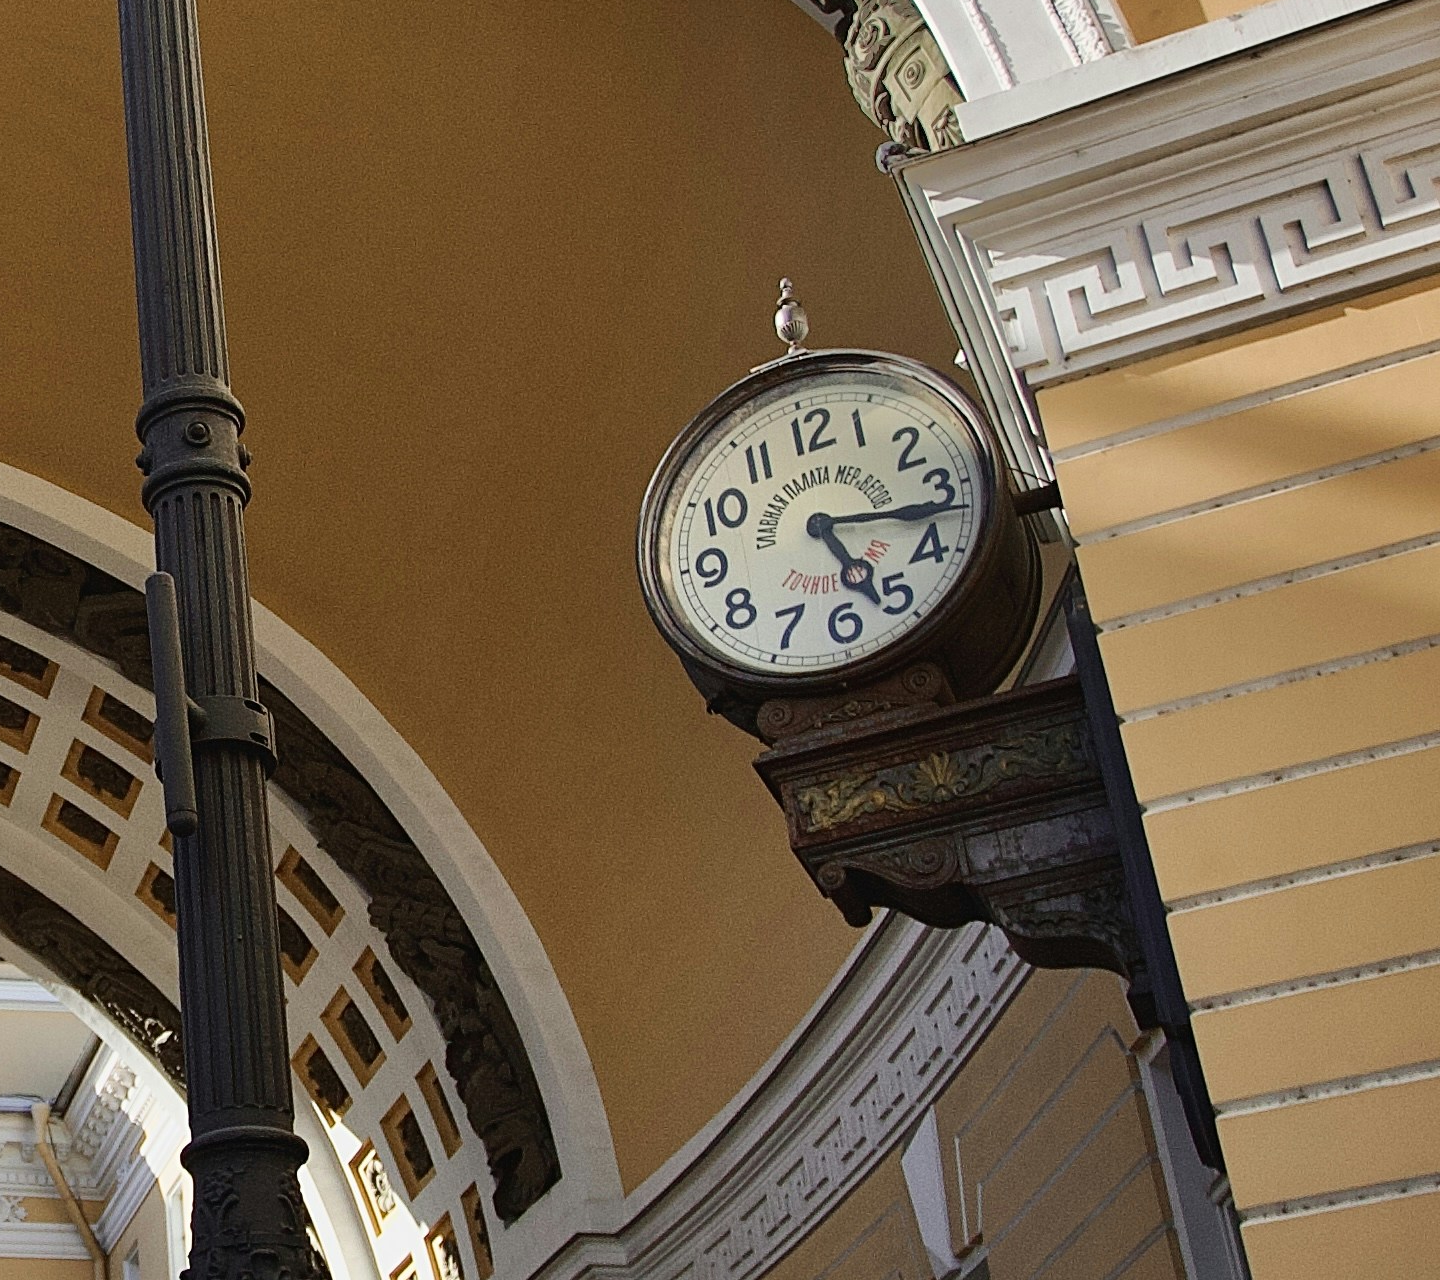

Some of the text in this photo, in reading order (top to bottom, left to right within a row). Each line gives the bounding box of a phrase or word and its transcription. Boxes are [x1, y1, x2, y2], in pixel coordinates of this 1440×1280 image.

[790, 407, 837, 456] 12
[850, 409, 866, 448] 1
[891, 426, 926, 472] 2
[744, 439, 773, 484] 11
[757, 494, 789, 550] ГЛАВНАЯ
[782, 465, 829, 500] ПАЛАТА
[835, 465, 862, 485] МЕР
[859, 474, 892, 509] ВЕСОВ
[922, 467, 957, 506] 3
[704, 487, 749, 536] 10
[908, 523, 949, 564] 4
[695, 547, 729, 588] 9
[782, 539, 891, 594] ТОЧНОЕ ВРМЯ
[725, 587, 757, 629] 8
[881, 572, 914, 615] 5
[774, 604, 805, 649] 7
[827, 602, 864, 644] 6
